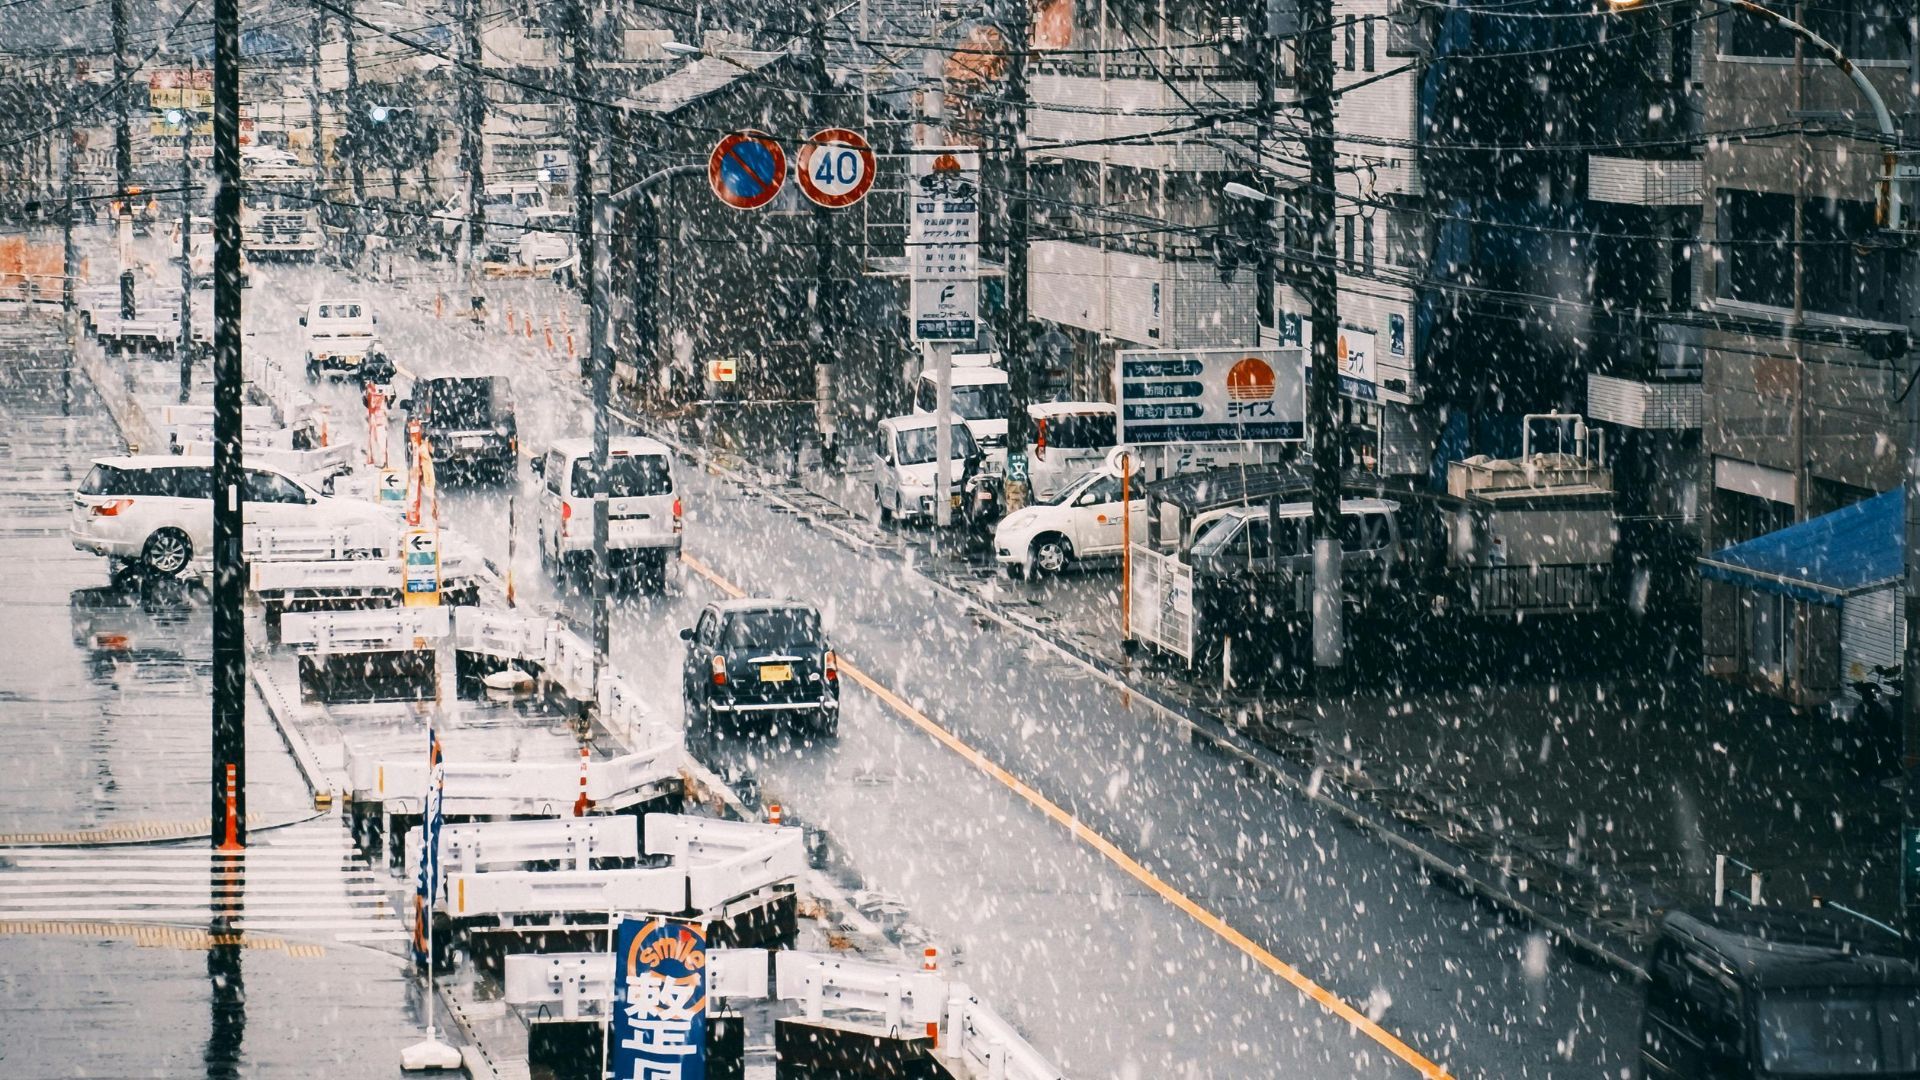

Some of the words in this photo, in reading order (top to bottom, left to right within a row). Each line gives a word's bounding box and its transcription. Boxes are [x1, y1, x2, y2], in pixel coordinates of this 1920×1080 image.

[815, 151, 857, 185] 40
[1134, 363, 1192, 375] デイサービス
[1348, 349, 1366, 374] ライズ
[1227, 400, 1276, 418] ライズ
[639, 929, 705, 971] smile
[621, 971, 698, 1080] 整
